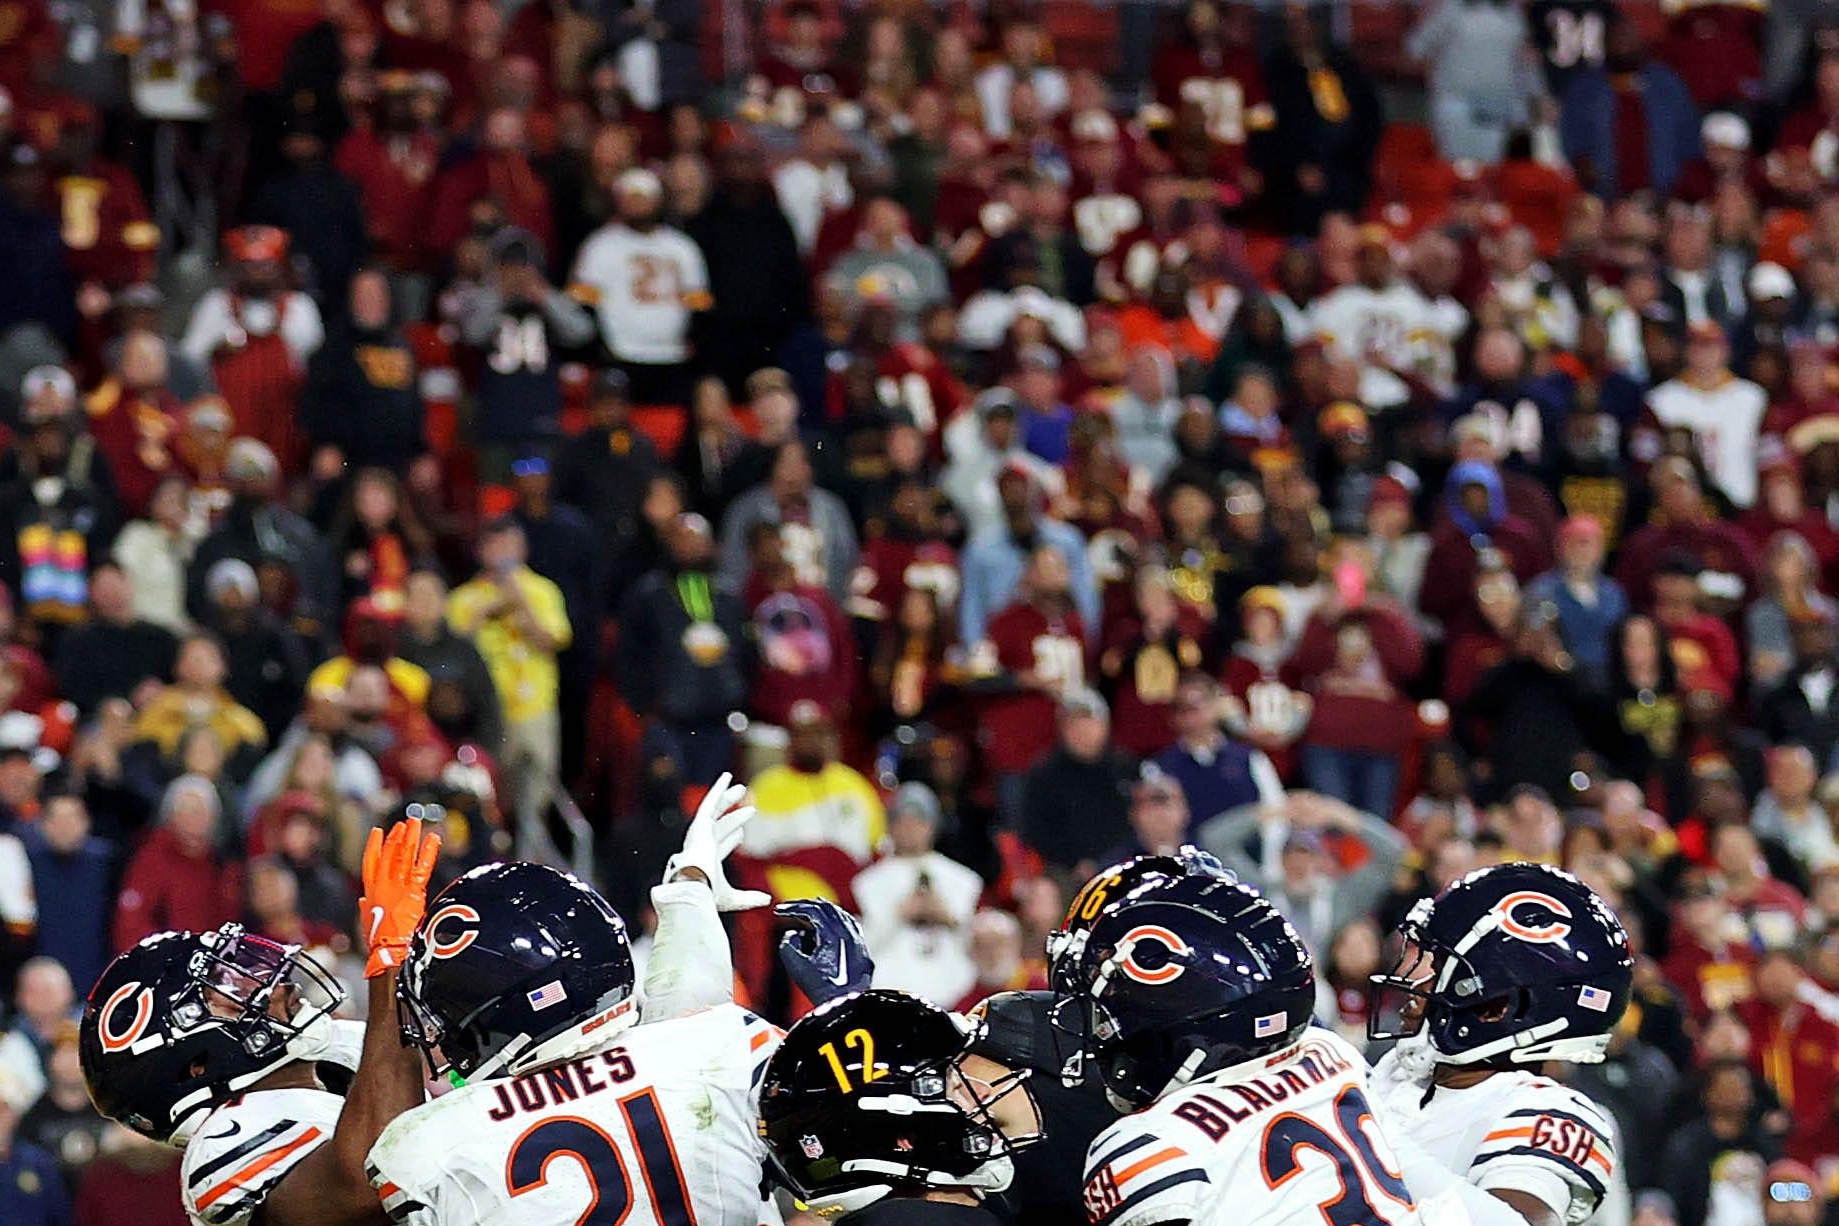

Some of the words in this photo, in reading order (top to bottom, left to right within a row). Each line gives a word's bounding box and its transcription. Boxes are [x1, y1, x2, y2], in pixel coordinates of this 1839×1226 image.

[487, 1044, 637, 1122] JONES
[818, 1028, 892, 1094] 12
[1171, 1047, 1353, 1143] BLACKLL
[1530, 1113, 1596, 1168] GSH
